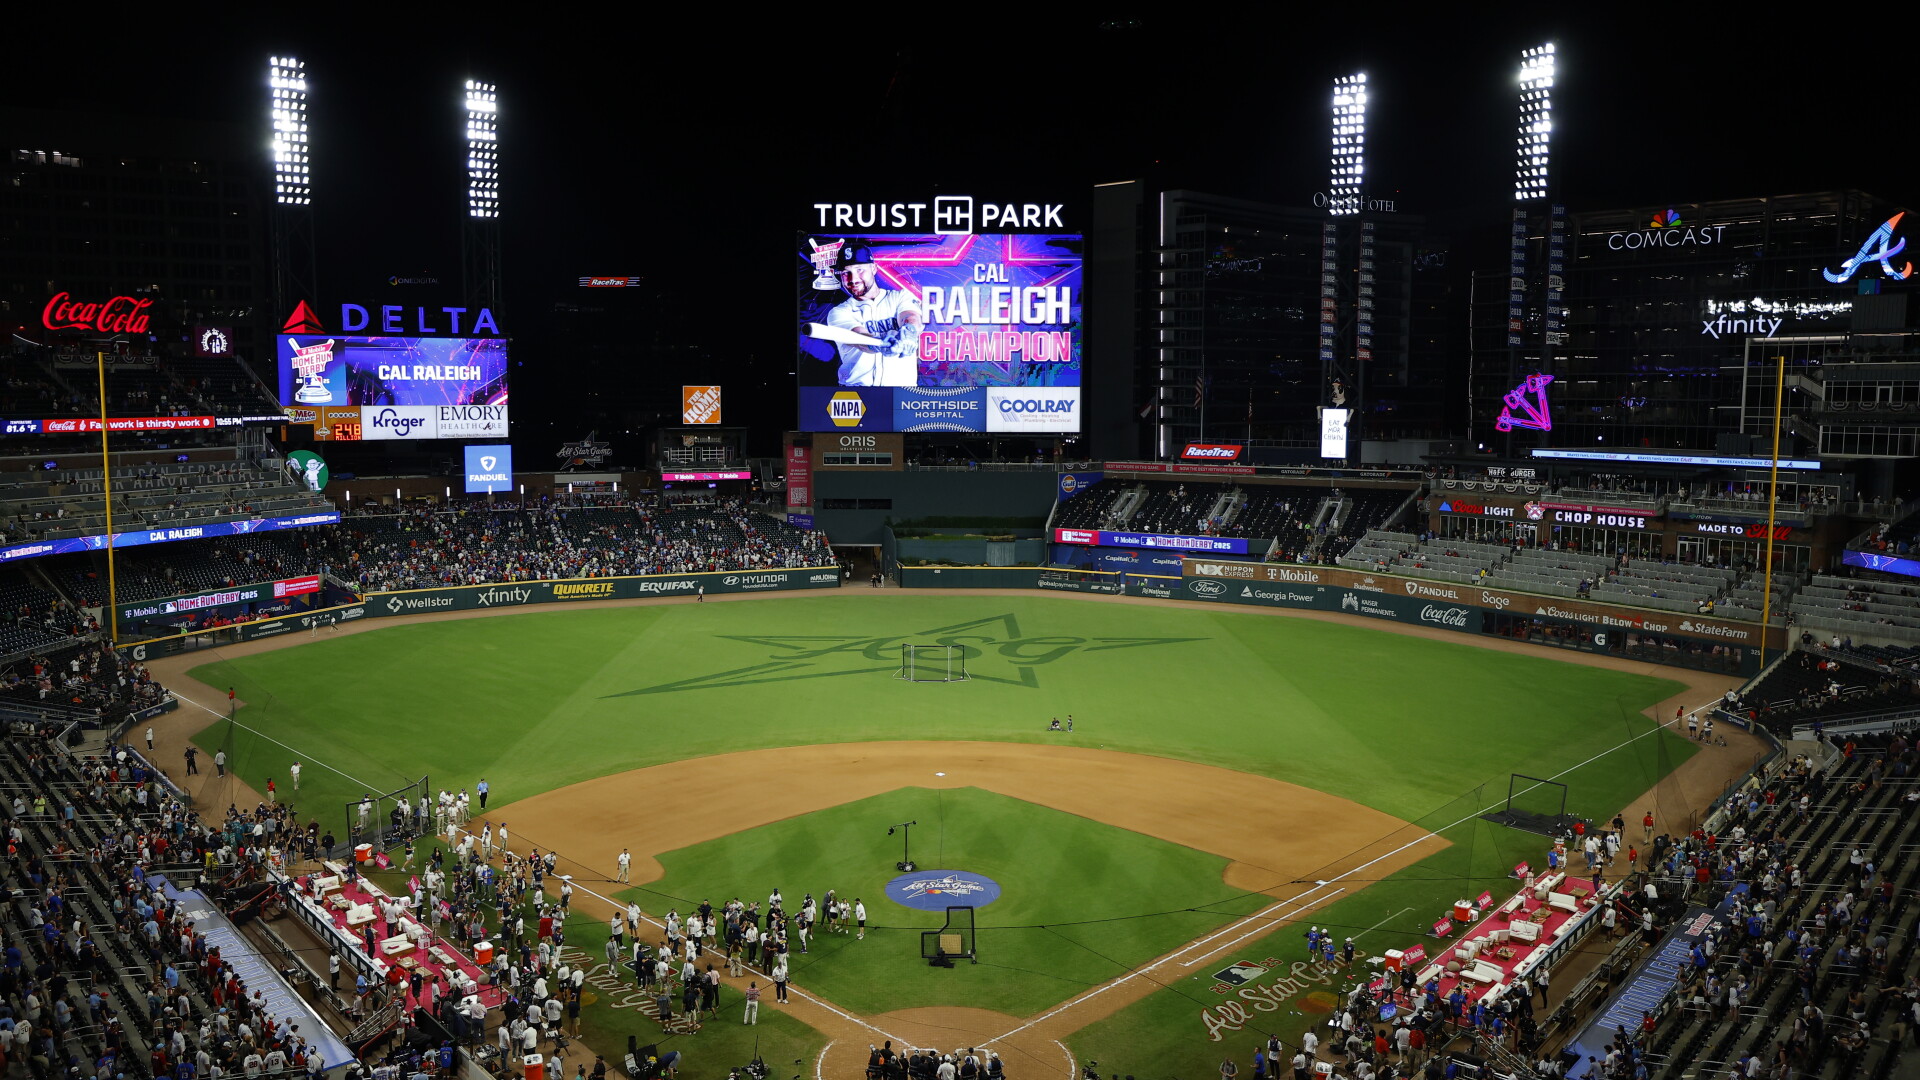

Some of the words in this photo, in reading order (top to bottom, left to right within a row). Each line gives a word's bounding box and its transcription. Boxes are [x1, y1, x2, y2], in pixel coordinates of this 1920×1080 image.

[813, 203, 926, 228] TRUIST
[981, 203, 1064, 228] PARK
[1608, 225, 1726, 250] COMCAST
[811, 252, 829, 263] HOME
[844, 248, 853, 260] S
[816, 258, 837, 269] DERBY
[973, 263, 1009, 283] CAL
[591, 278, 624, 286] RaceTrac
[921, 286, 1071, 325] RALEIGH
[42, 292, 154, 333] Coca-Cola
[341, 303, 500, 334] DELTA
[1701, 314, 1783, 339] xfinity
[918, 331, 1071, 362] CHAMPION
[292, 355, 315, 369] HOME
[315, 351, 333, 363] RUN
[300, 362, 325, 376] DERBY
[378, 364, 411, 381] CAL
[413, 364, 481, 381] RALEIGH
[687, 390, 703, 405] THE
[684, 386, 721, 423] HOME
[833, 402, 860, 417] NAPA
[901, 401, 978, 410] NORTHSIDE
[1000, 400, 1075, 413] COOLRAY
[295, 409, 316, 418] MEGA
[440, 405, 504, 420] EMORY
[698, 400, 721, 423] DEPOT
[27, 424, 37, 432] °F
[48, 421, 76, 431] Coca-Cola
[109, 420, 134, 428] work
[136, 420, 144, 428] is
[146, 419, 177, 429] thirsty
[178, 418, 200, 427] work
[216, 417, 232, 426] 10:55
[232, 417, 242, 425] PM
[373, 408, 425, 436] Kroger
[335, 425, 361, 435] 248
[840, 436, 876, 446] ORIS
[573, 446, 590, 456] Star
[1186, 446, 1235, 457] RaceTrac
[469, 474, 508, 482] FANDUEL
[1062, 480, 1076, 488] Gulf
[79, 480, 124, 493] HAK
[1452, 500, 1484, 515] Coors
[1484, 506, 1515, 517] LIGHT
[1555, 510, 1592, 524] CHOP
[1597, 515, 1645, 529] HOUSE
[243, 521, 249, 532] S
[1698, 523, 1727, 533] MADE
[1730, 526, 1744, 534] TO
[150, 530, 167, 541] CAL
[169, 528, 203, 540] RALEIGH
[95, 536, 101, 547] S
[1120, 537, 1140, 545] Mobile
[1156, 537, 1176, 548] HOME
[1176, 538, 1190, 548] RUN
[1190, 539, 1213, 549] DERBY
[1872, 555, 1879, 567] S
[1224, 565, 1254, 573] NIPPON
[1224, 570, 1254, 578] EXPRESS
[742, 574, 788, 584] HYUNDAI
[1280, 569, 1319, 583] Mobile
[553, 582, 614, 595] QUIKRETE
[640, 581, 695, 593] EQUIFAX
[1194, 581, 1220, 594] Ford
[1353, 583, 1385, 593] Budweiser
[1418, 586, 1459, 599] FANDUEL
[478, 586, 532, 606] xfinity
[1255, 589, 1287, 601] Georgia
[1288, 592, 1314, 602] Power
[1482, 591, 1510, 610] Sage
[133, 607, 158, 617] Mobile
[177, 598, 200, 611] HOME
[200, 595, 216, 607] RUN
[216, 591, 241, 605] DERBY
[240, 590, 258, 600] 2025
[405, 596, 454, 609] Wellstar
[1361, 599, 1378, 607] KAISER
[1420, 604, 1470, 627] Coca-Cola
[1547, 606, 1574, 620] Coors
[1575, 613, 1599, 623] LIGHT
[1602, 615, 1633, 628] BELOW
[1643, 621, 1668, 633] CHOP
[1594, 633, 1606, 646] G
[132, 645, 146, 661] G
[902, 882, 926, 891] All
[951, 882, 984, 891] Game
[1439, 921, 1451, 932] Mobile
[1409, 949, 1424, 959] Mobile
[1209, 982, 1234, 995] 20
[1260, 956, 1284, 969] 25
[1202, 1000, 1253, 1042] All
[1238, 974, 1310, 1012] Star
